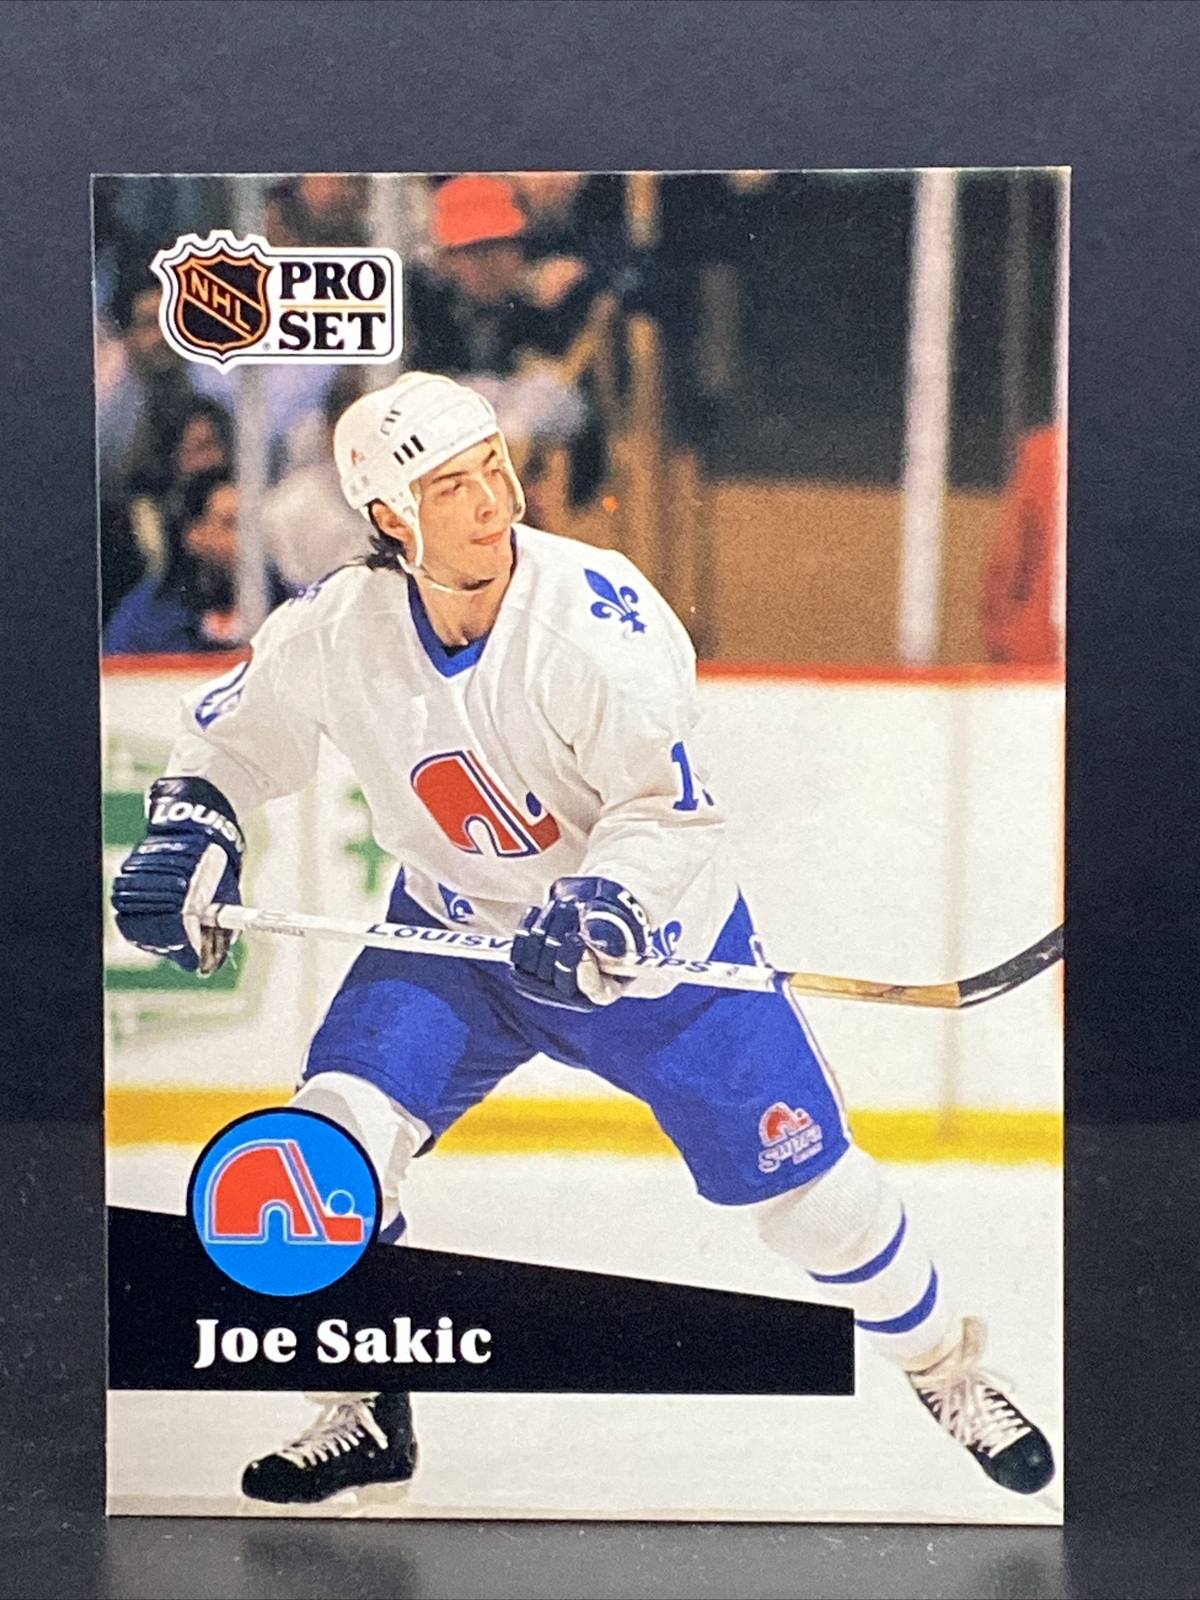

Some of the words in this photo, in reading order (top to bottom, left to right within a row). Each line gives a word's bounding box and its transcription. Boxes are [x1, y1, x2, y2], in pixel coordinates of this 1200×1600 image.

[189, 269, 252, 332] NHL
[279, 259, 387, 301] PRO
[278, 309, 386, 351] SET
[670, 740, 715, 812] 1
[193, 1318, 298, 1369] Joe
[316, 1316, 492, 1364] Sakic
